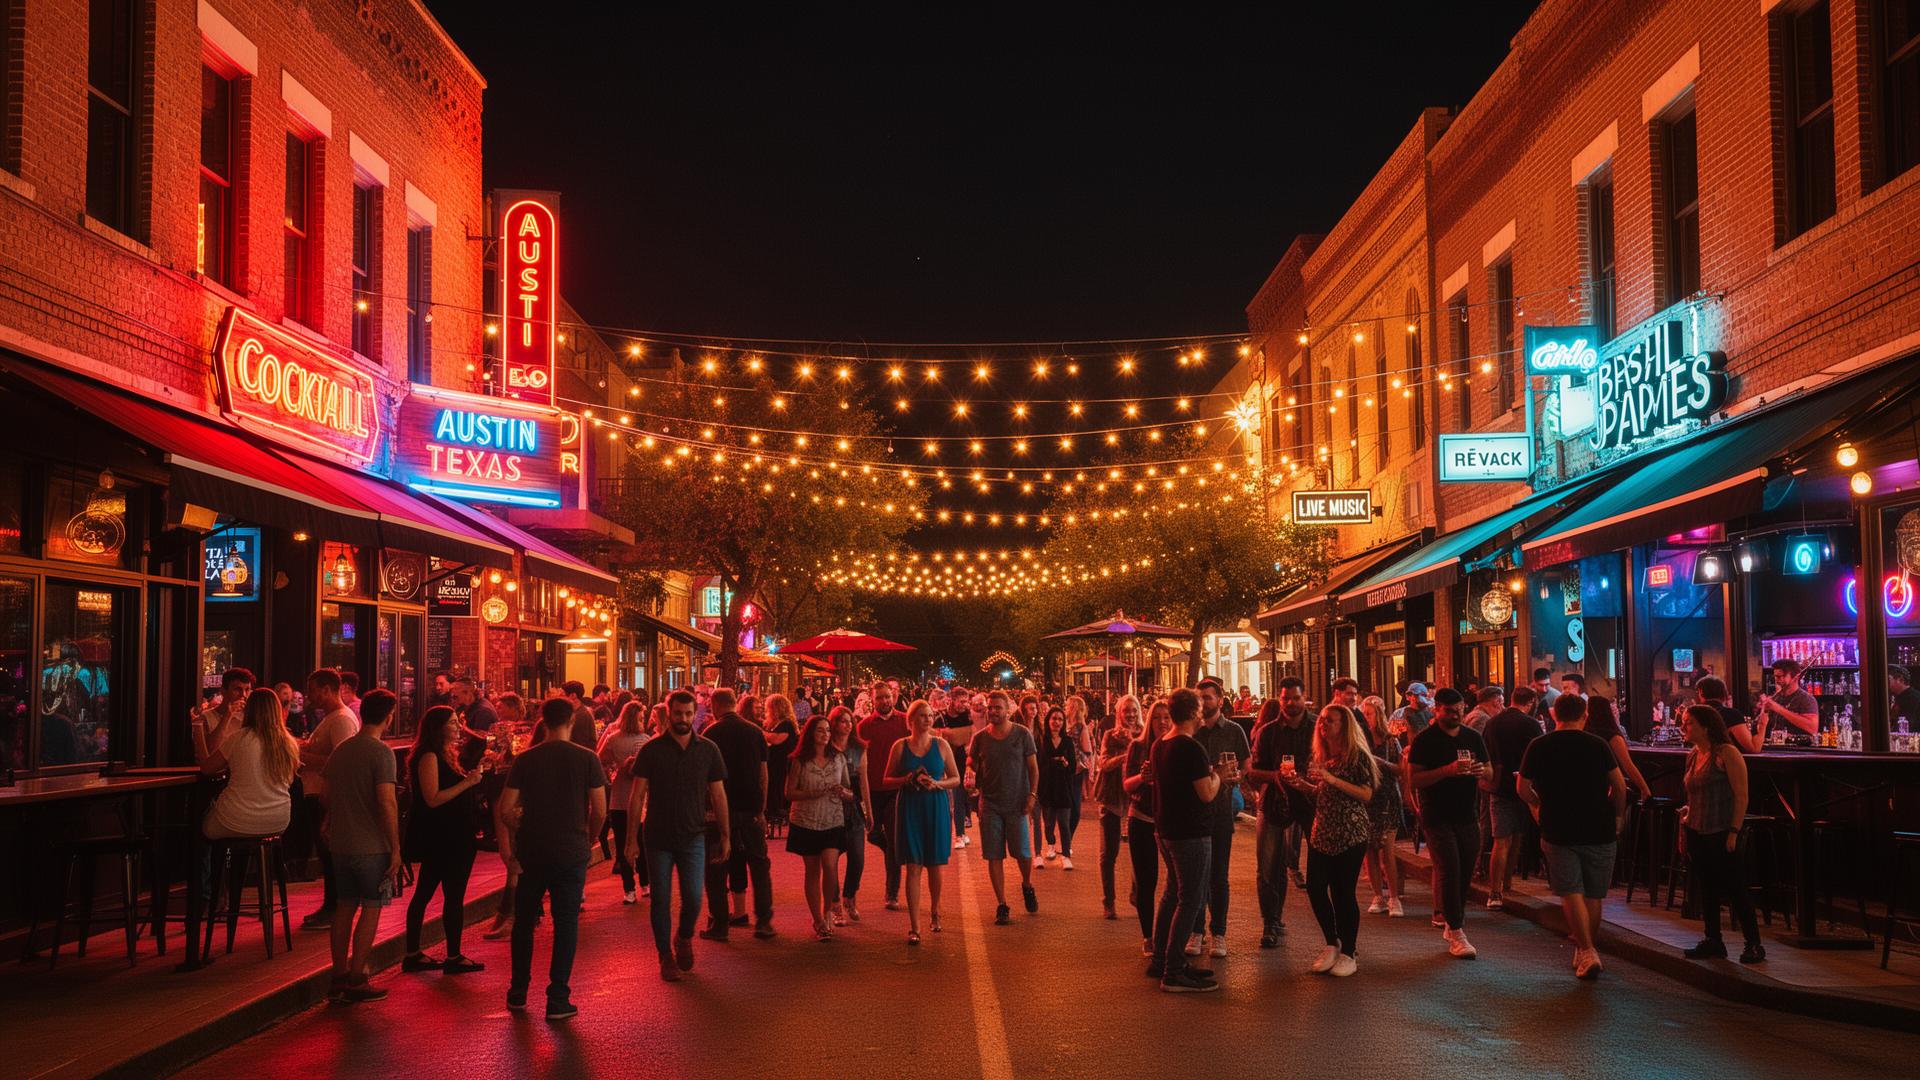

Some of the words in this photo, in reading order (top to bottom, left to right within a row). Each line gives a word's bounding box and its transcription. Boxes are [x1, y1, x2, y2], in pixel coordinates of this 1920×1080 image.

[436, 408, 536, 452] AUSTIN
[425, 444, 521, 482] TEXAS
[1299, 499, 1327, 517] LIVE
[1329, 498, 1367, 516] MUSIC
